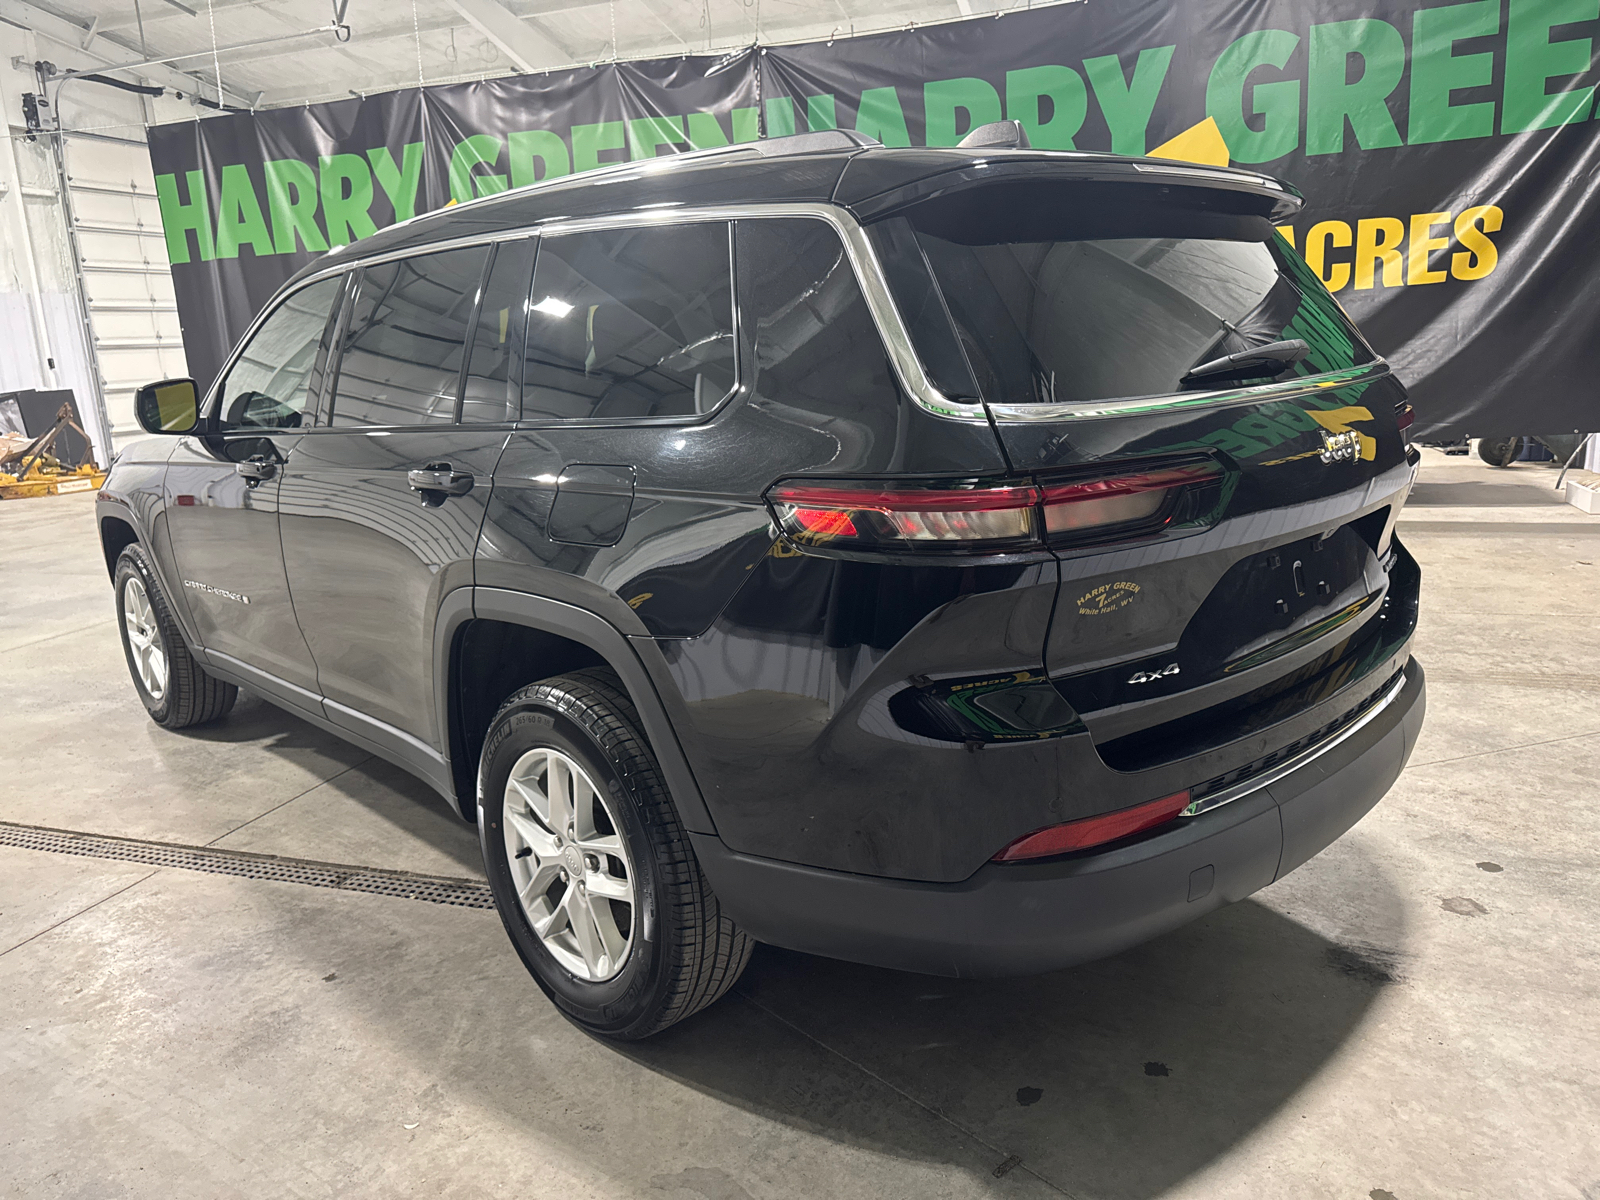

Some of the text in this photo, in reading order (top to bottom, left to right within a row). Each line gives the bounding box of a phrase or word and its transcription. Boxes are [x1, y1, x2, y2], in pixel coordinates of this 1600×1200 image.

[1206, 0, 1600, 164] GREE
[155, 141, 425, 264] HARRY
[1275, 205, 1504, 293] CRES
[1076, 581, 1141, 606] HARRY GREEN
[1079, 607, 1100, 616] White
[1121, 595, 1135, 607] WV
[1095, 589, 1125, 609] 7 ACRES
